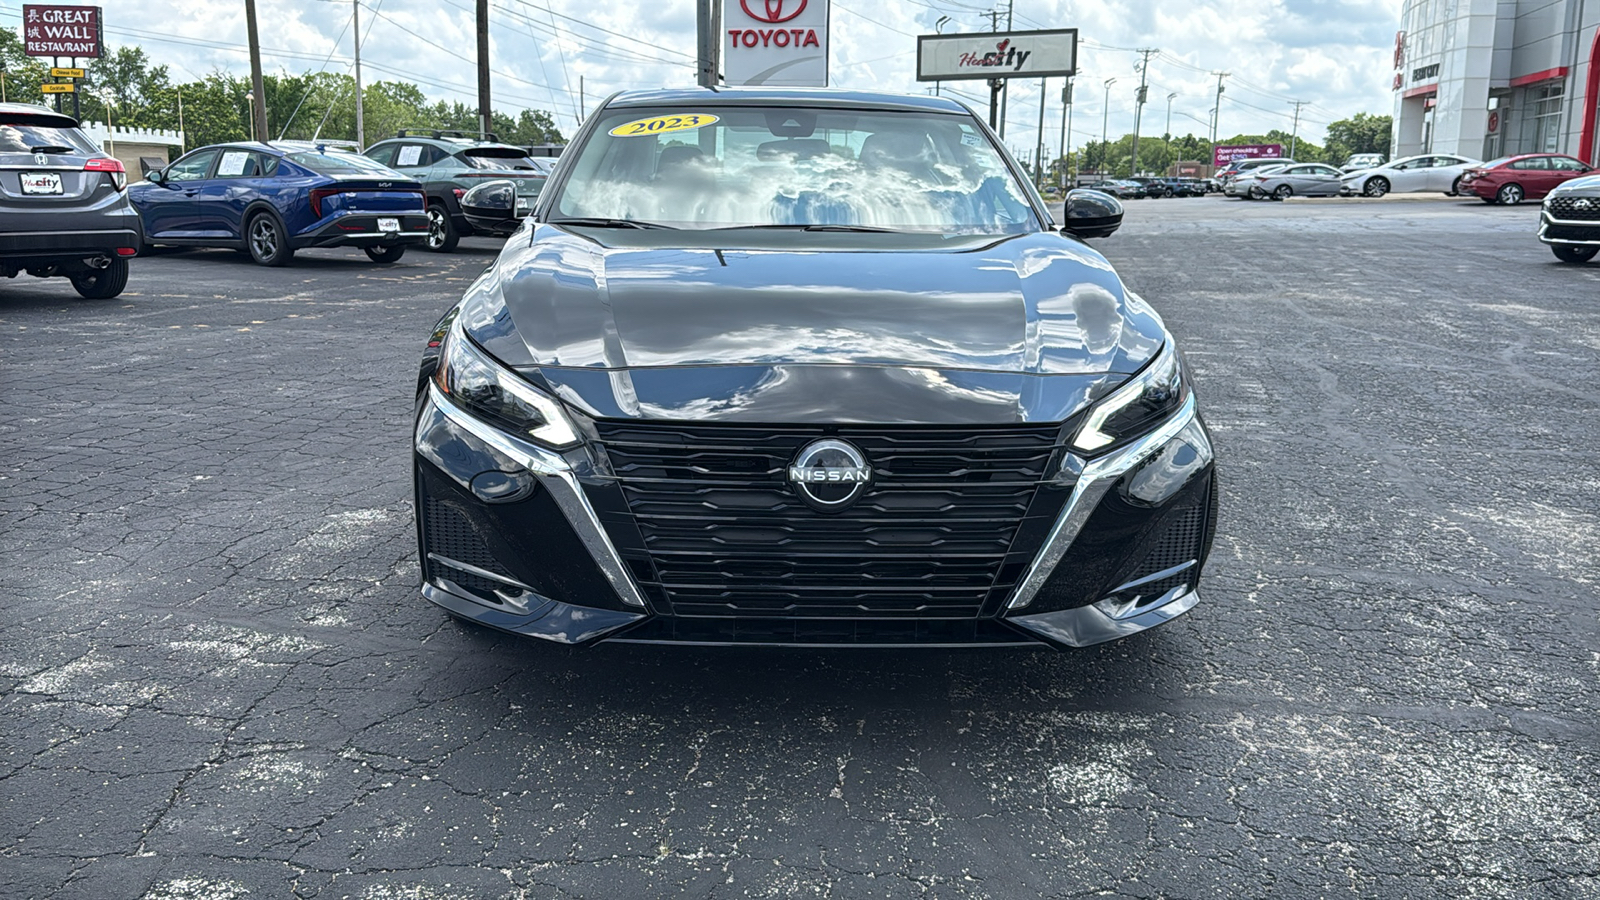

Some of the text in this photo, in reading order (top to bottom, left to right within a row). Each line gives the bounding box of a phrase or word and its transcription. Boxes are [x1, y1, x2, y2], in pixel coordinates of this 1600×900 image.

[42, 10, 92, 23] GREAT
[44, 26, 91, 39] WALL
[728, 29, 820, 48] TOYOTA
[27, 41, 95, 53] RESTAURANT
[629, 116, 700, 134] 2023
[792, 469, 869, 481] NISSAN
